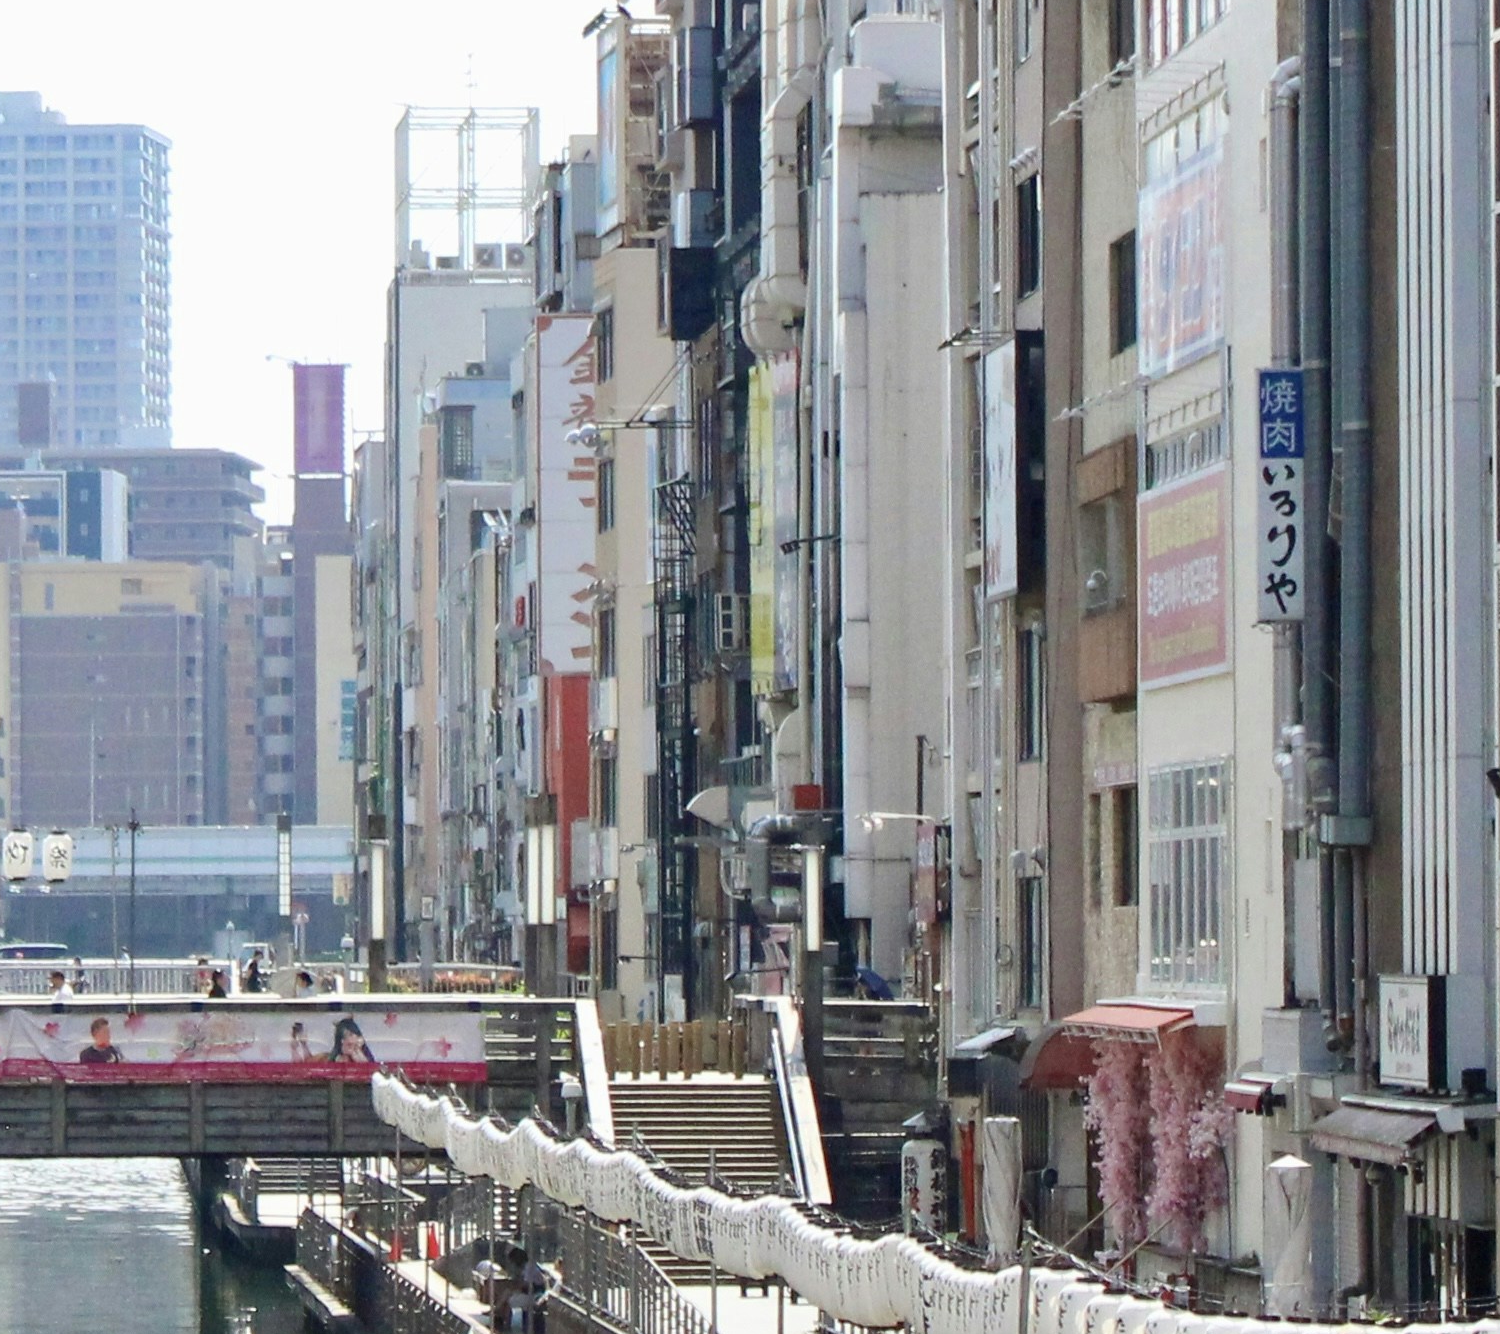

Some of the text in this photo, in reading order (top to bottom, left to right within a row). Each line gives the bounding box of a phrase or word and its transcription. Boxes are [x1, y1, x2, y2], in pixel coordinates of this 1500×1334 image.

[1261, 379, 1297, 454] 焼肉
[1261, 464, 1297, 615] いろりや
